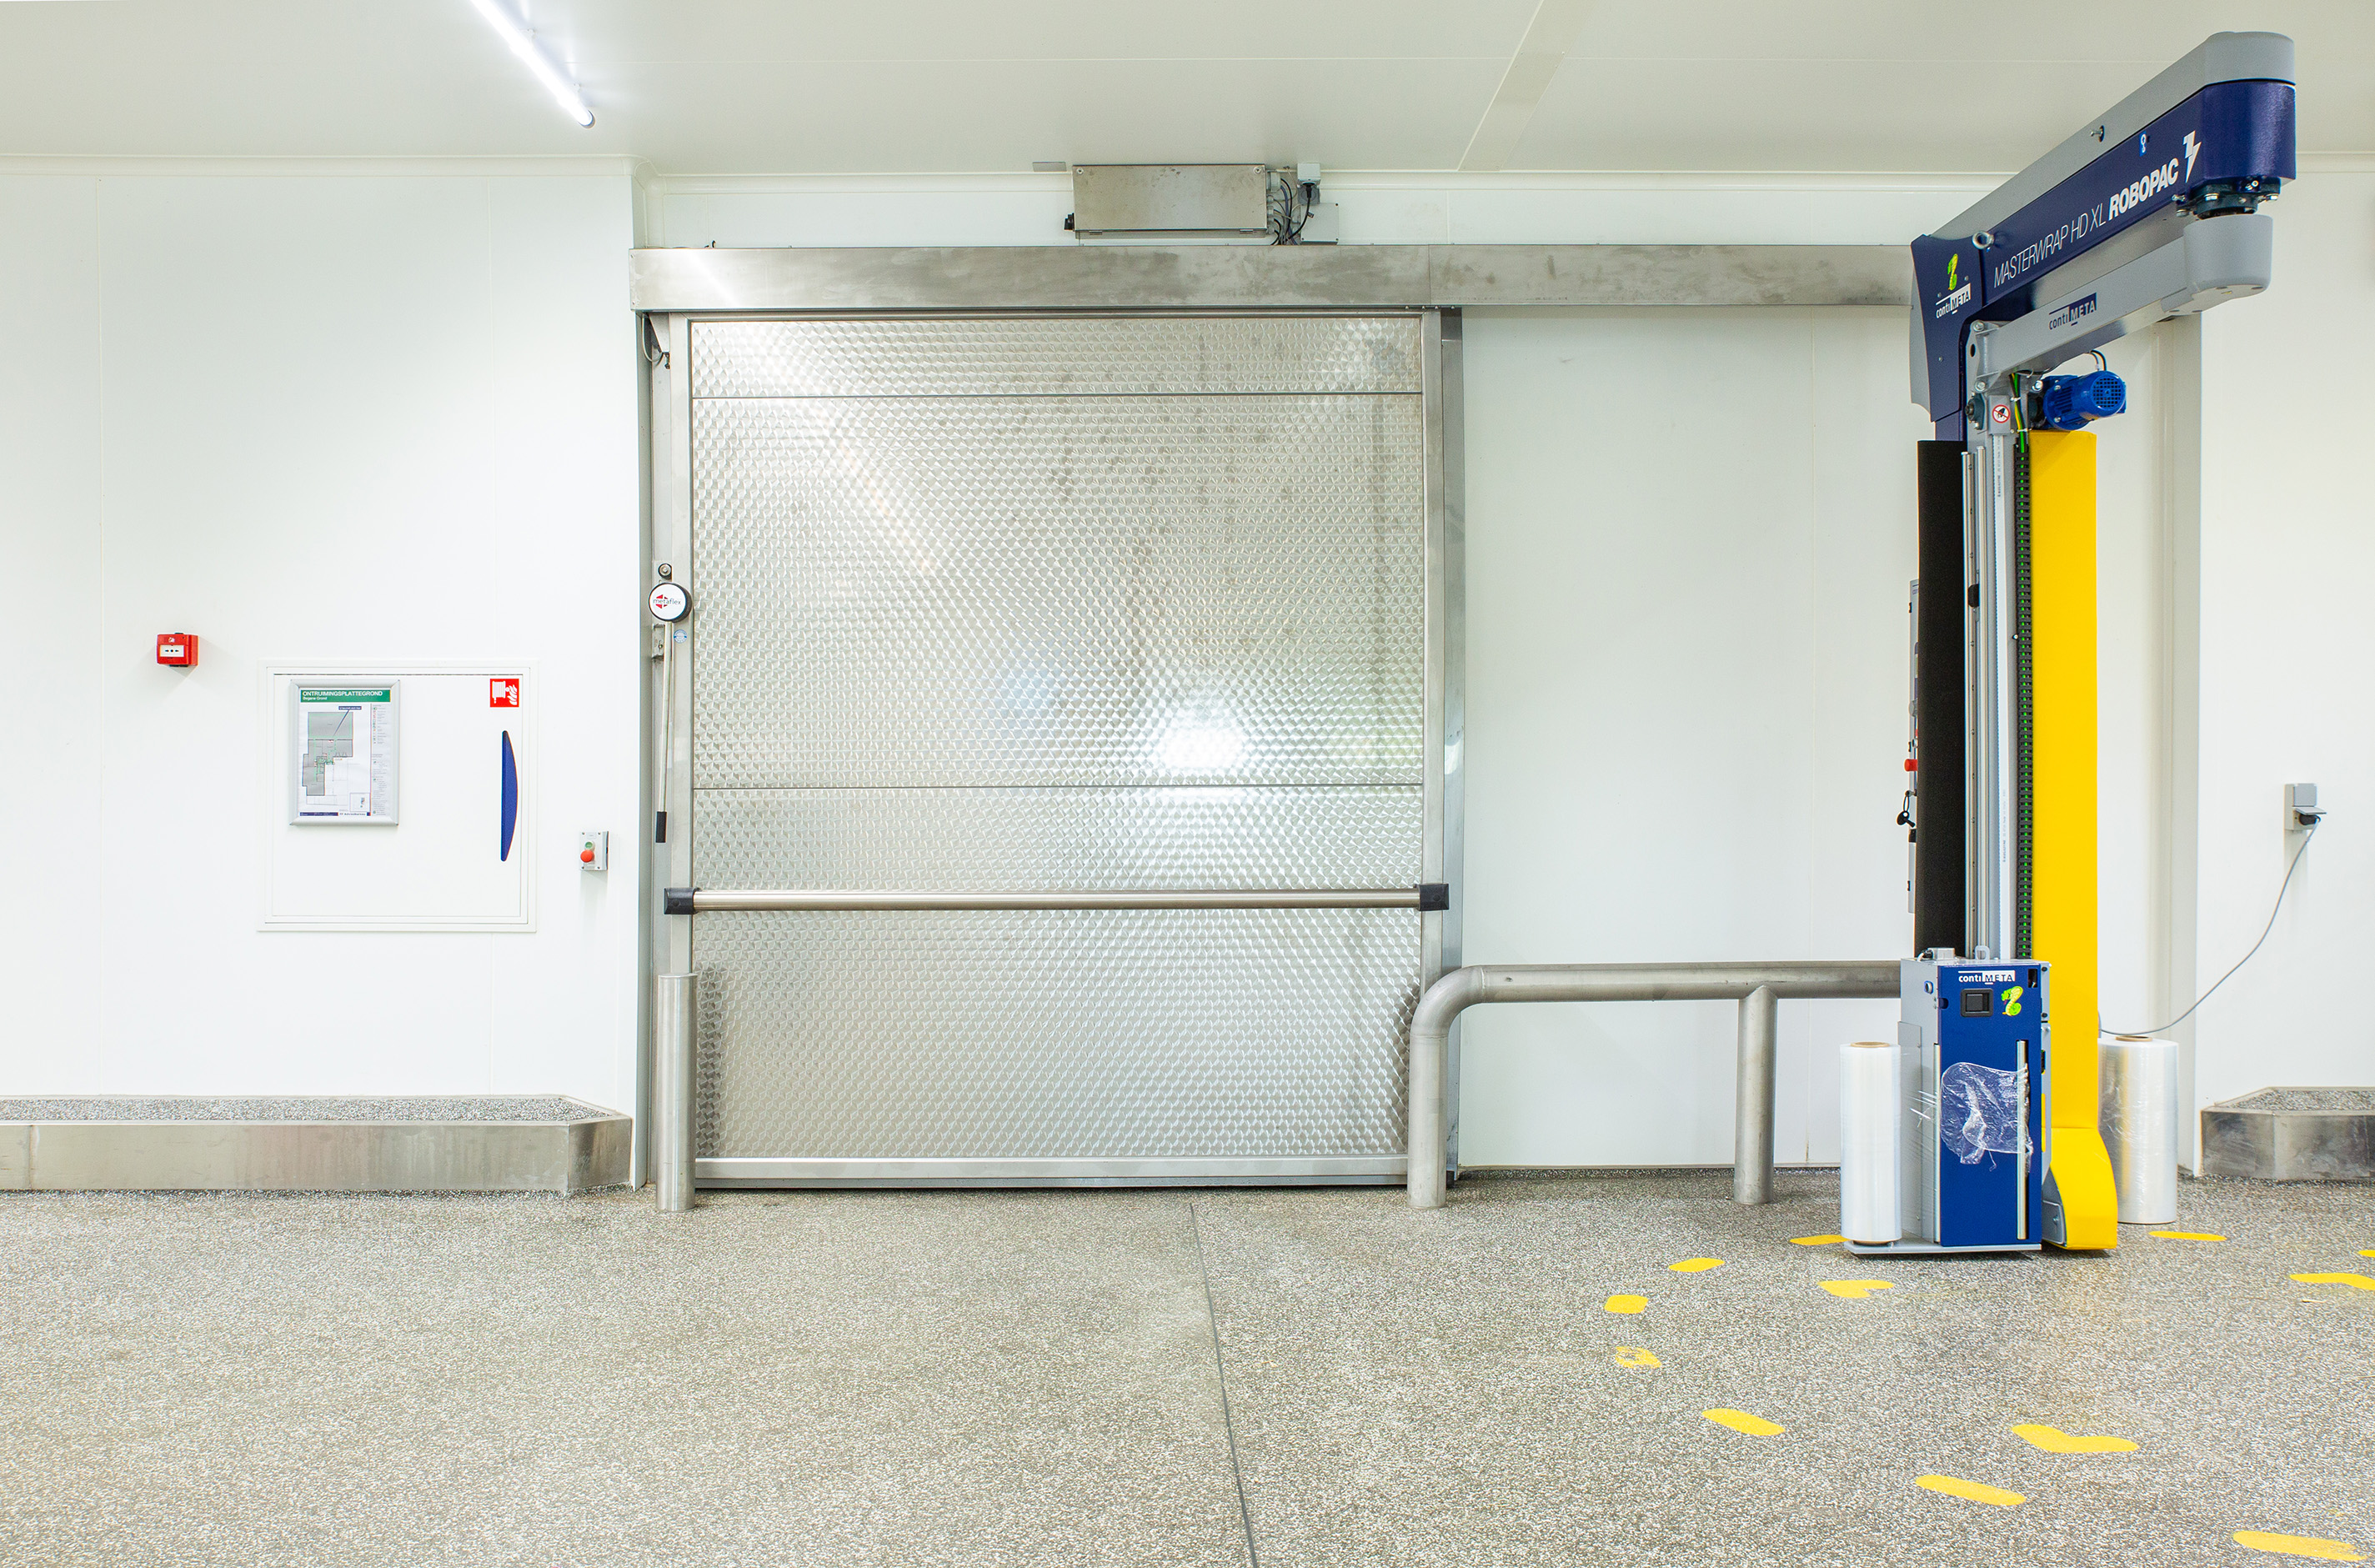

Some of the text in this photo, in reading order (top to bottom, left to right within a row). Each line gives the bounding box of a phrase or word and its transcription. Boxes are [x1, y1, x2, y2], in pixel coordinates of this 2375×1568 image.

[1994, 158, 2180, 288] MASTERWRAP HD XL ROBOPAC
